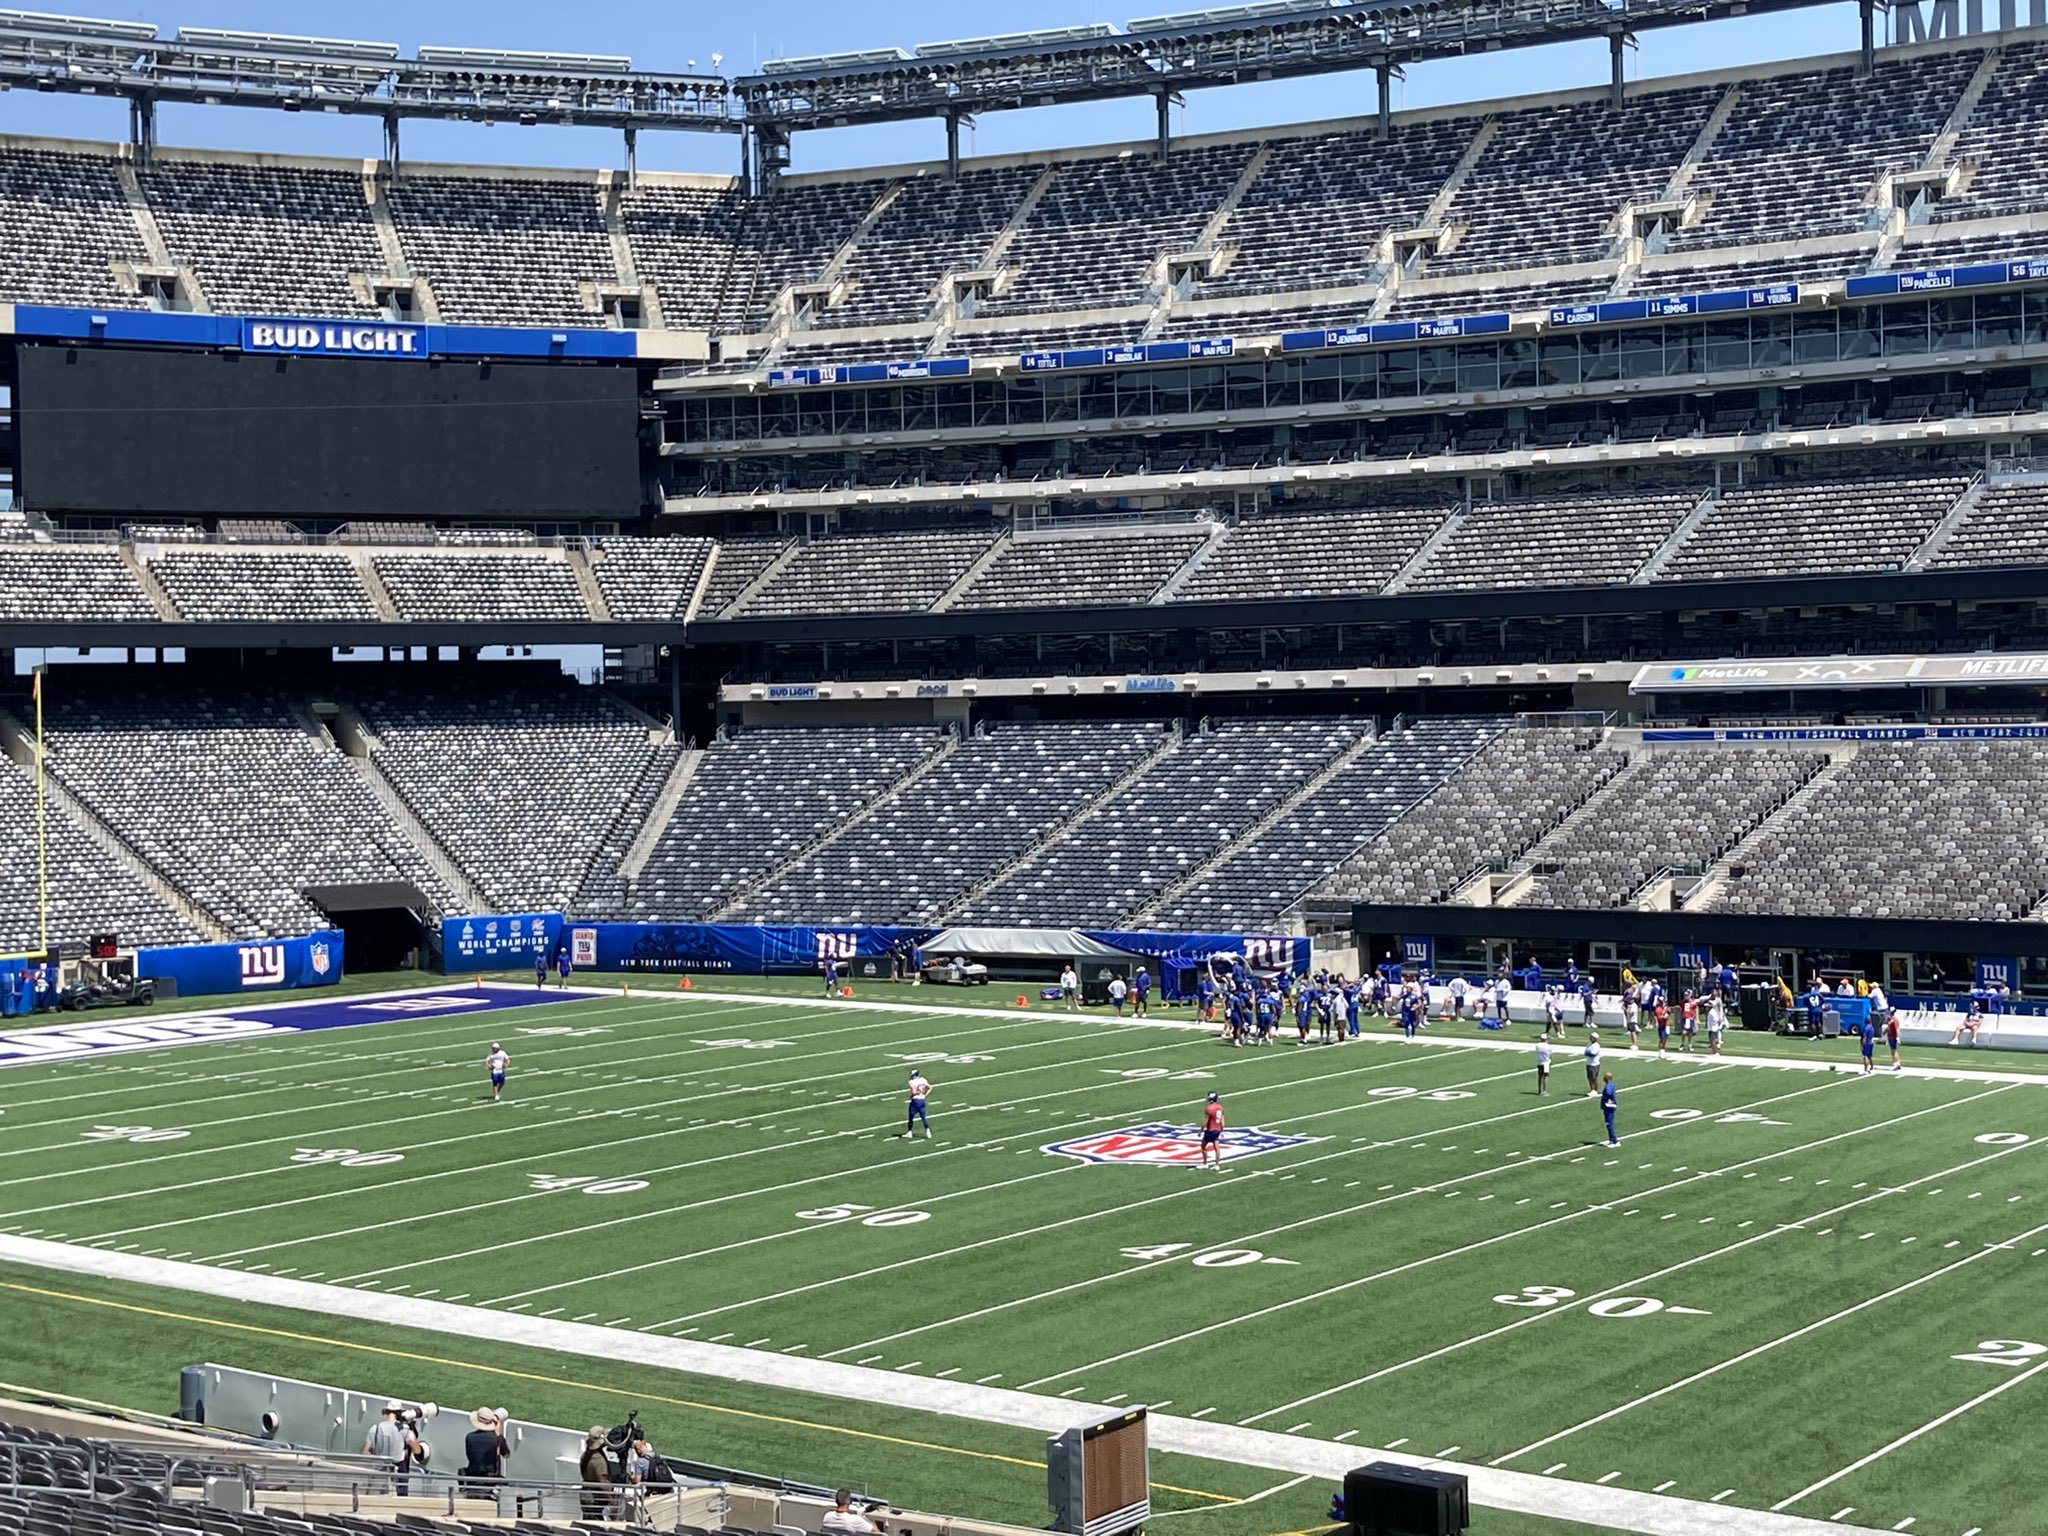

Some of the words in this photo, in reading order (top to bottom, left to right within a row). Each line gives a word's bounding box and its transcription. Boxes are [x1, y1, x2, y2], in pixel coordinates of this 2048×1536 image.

[2013, 266, 2025, 276] 56
[1914, 277, 1951, 289] PARCELLS
[1767, 293, 1792, 304] YOUNG
[1651, 302, 1661, 312] 11
[1663, 304, 1688, 314] SIMMS
[1553, 312, 1565, 321] 53
[1567, 313, 1594, 323] CARSON
[252, 324, 320, 348] BUD
[1420, 325, 1431, 334] 75
[1433, 325, 1459, 336] MARTIN
[1328, 333, 1337, 342] 13
[1191, 345, 1200, 353] 10
[1107, 351, 1113, 360] 3
[1026, 357, 1035, 367] 14
[1698, 668, 1769, 678] MetLife
[769, 688, 788, 697] BUD
[790, 687, 815, 697] LIGHT
[1743, 731, 1764, 739] NEW
[1772, 731, 1799, 739] YORK
[1867, 730, 1908, 738] GIANTS
[458, 940, 491, 949] WORLD
[496, 936, 549, 948] CHAMPIONS
[1406, 942, 1427, 961] ny
[239, 945, 285, 985] ny
[1982, 963, 2007, 985] ny
[1320, 995, 1331, 1006] 72
[1684, 1002, 1691, 1012] 2
[1919, 1001, 1957, 1012] NEW
[795, 1203, 931, 1226] 50
[1119, 1243, 1264, 1267] 40
[1492, 1286, 1665, 1317] 30
[1950, 1340, 2048, 1367] 2
